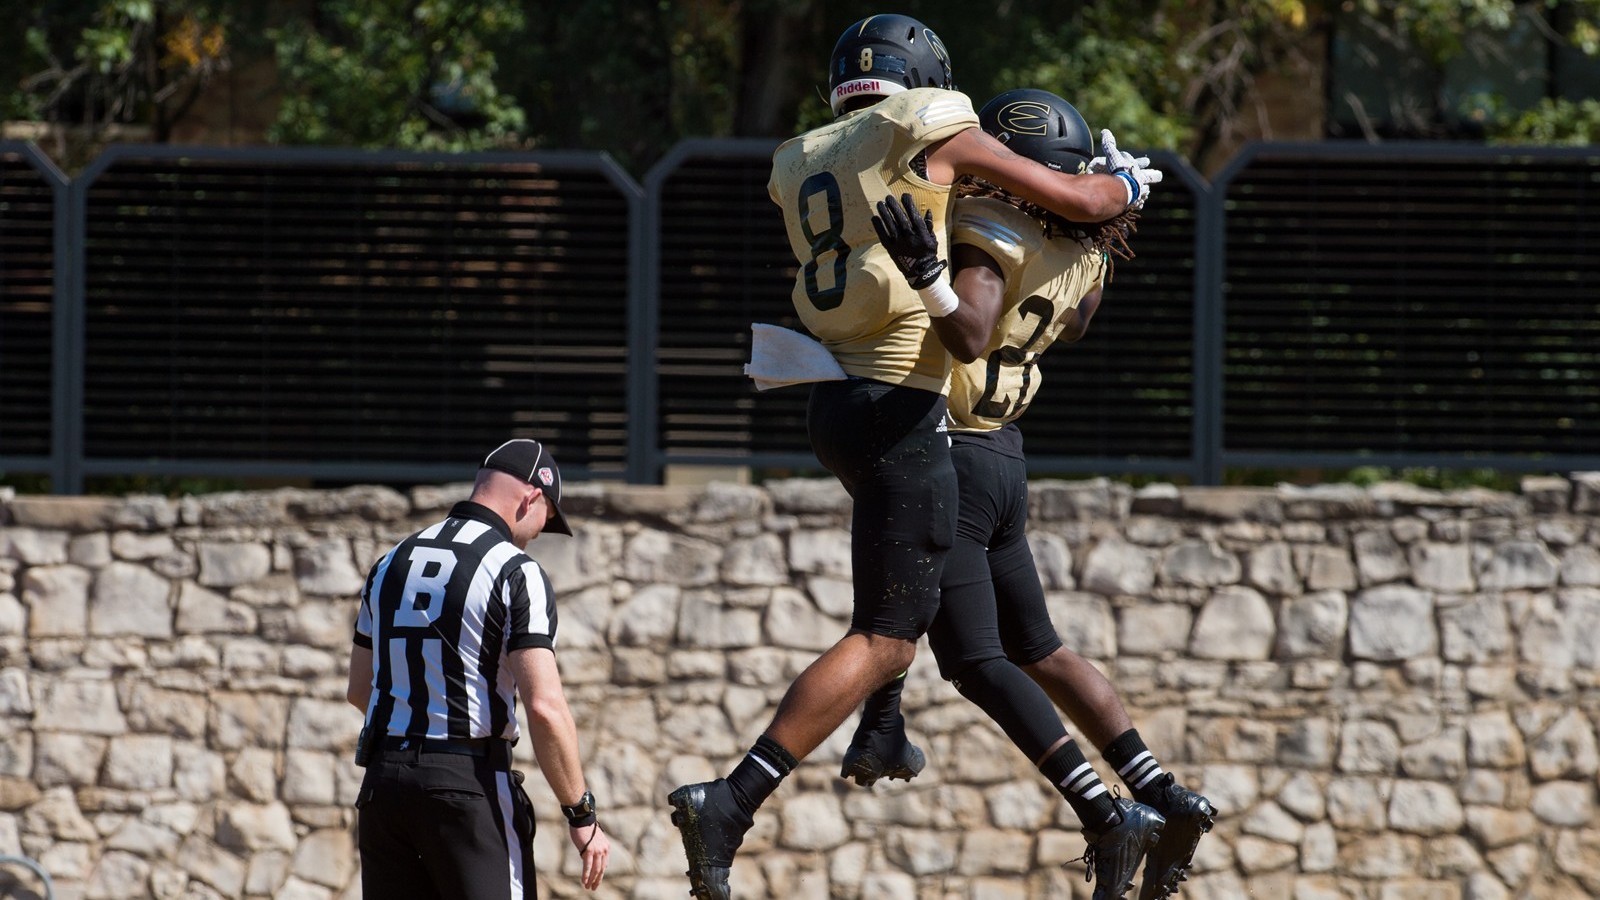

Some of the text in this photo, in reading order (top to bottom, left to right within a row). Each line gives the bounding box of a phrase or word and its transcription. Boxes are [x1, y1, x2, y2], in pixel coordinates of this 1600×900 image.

[860, 48, 873, 72] 8
[836, 81, 880, 97] Riddell
[798, 171, 851, 311] 8
[922, 263, 944, 280] adizero
[393, 546, 458, 627] B
